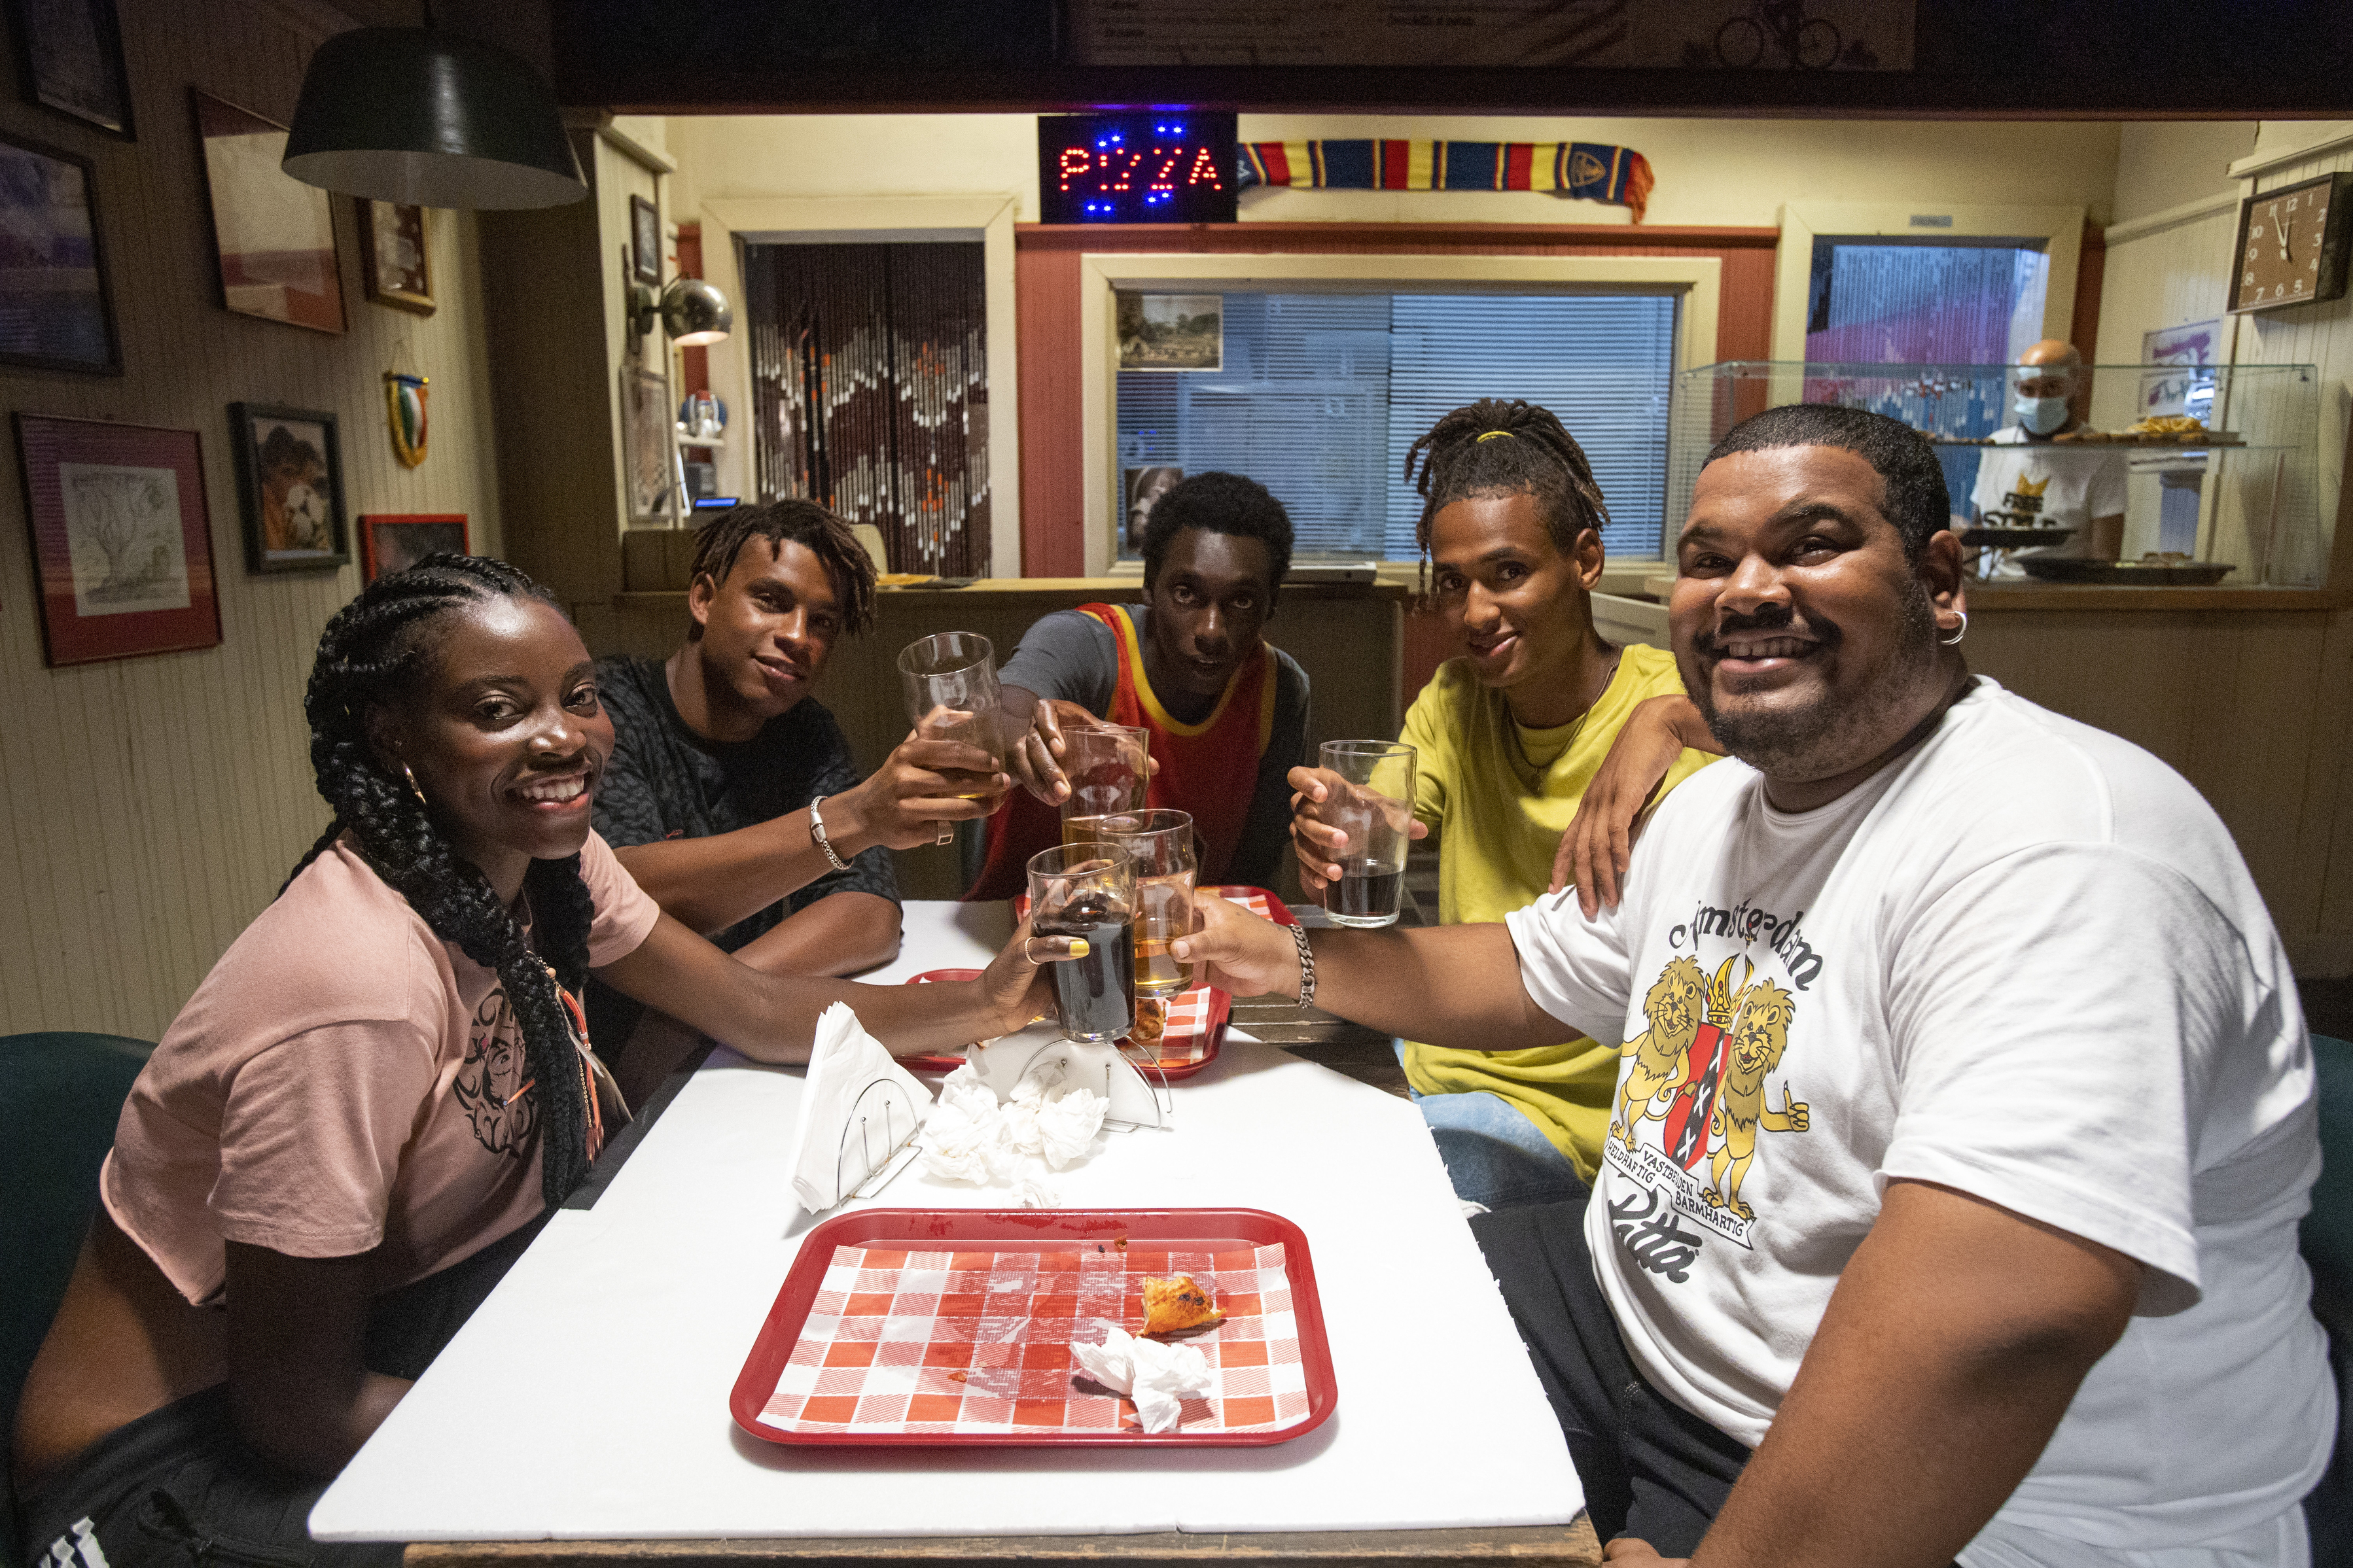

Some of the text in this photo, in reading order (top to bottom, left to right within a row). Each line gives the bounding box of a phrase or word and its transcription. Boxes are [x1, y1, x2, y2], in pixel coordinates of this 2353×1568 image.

[1059, 147, 1222, 191] PIZZA
[2286, 198, 2298, 213] 12
[2316, 208, 2326, 222] 2
[2252, 225, 2263, 239] 10
[2312, 233, 2322, 247] 3
[2249, 248, 2258, 261] 9
[2309, 258, 2318, 271] 4
[2244, 272, 2254, 286] 8
[2293, 279, 2303, 293] 5
[2255, 287, 2265, 304] 7
[2275, 283, 2284, 297] 6
[1669, 898, 1823, 991] Amsterdam
[1607, 1140, 1655, 1183] HELDHAFTIG
[1644, 1150, 1693, 1197] VASTBEDEN
[1674, 1191, 1744, 1237] BARMHARTIG
